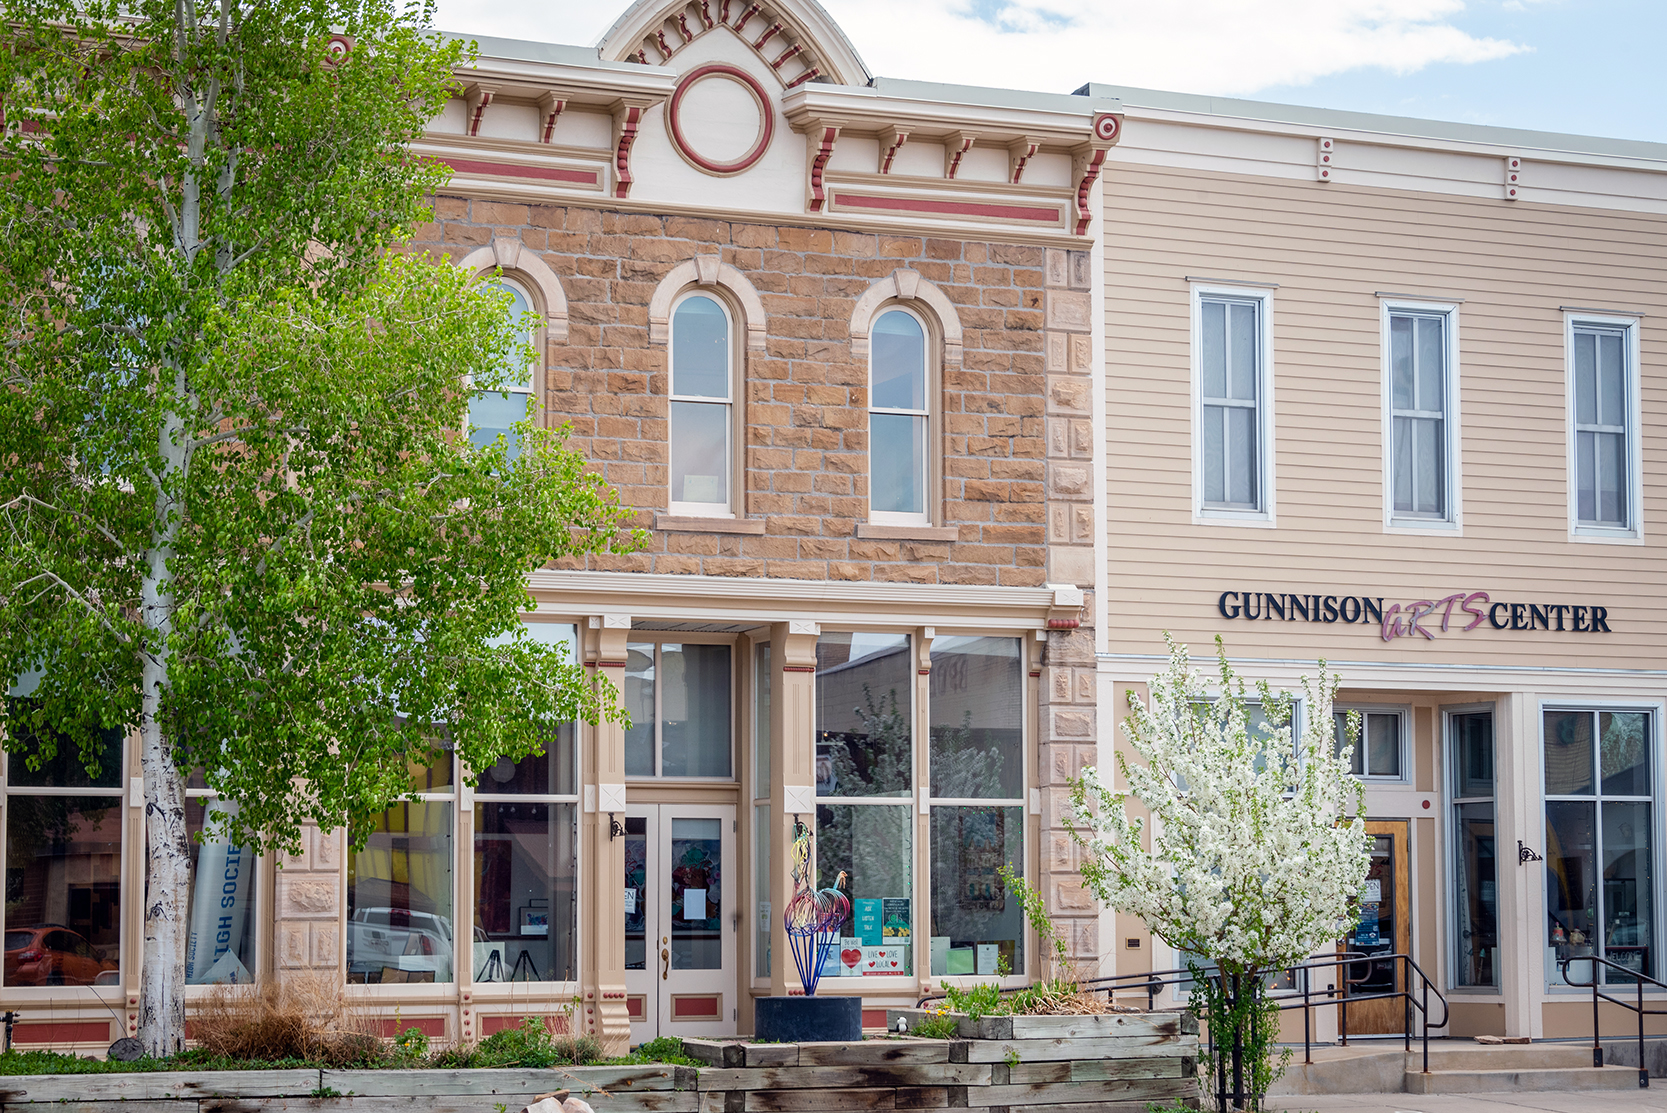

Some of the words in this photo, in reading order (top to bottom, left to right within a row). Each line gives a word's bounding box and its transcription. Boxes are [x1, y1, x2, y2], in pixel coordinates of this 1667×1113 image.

[1218, 591, 1384, 625] GUNNISON
[1489, 602, 1612, 633] CENTER
[220, 818, 243, 908] SOCIE
[188, 931, 198, 960] SOCIETY
[213, 916, 233, 964] IGH
[868, 950, 878, 958] LIVE
[886, 950, 898, 958] LOVE
